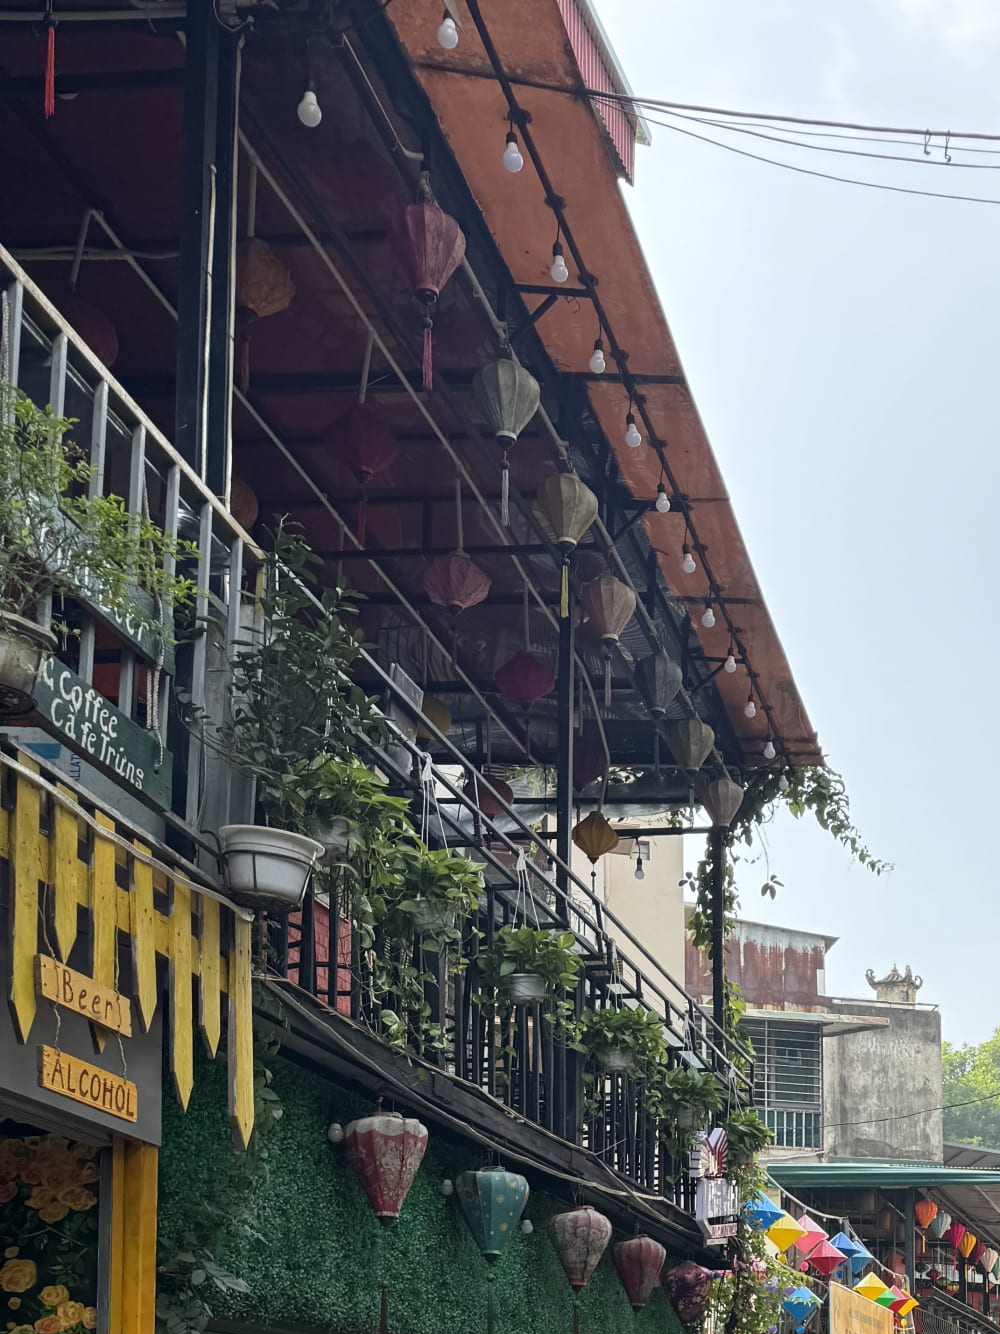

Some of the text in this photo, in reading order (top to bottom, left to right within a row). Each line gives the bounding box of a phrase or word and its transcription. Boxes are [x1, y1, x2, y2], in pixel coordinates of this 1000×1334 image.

[60, 671, 118, 738] Coffee
[62, 968, 113, 1021] Beer
[51, 1057, 134, 1118] ALCOHOL
